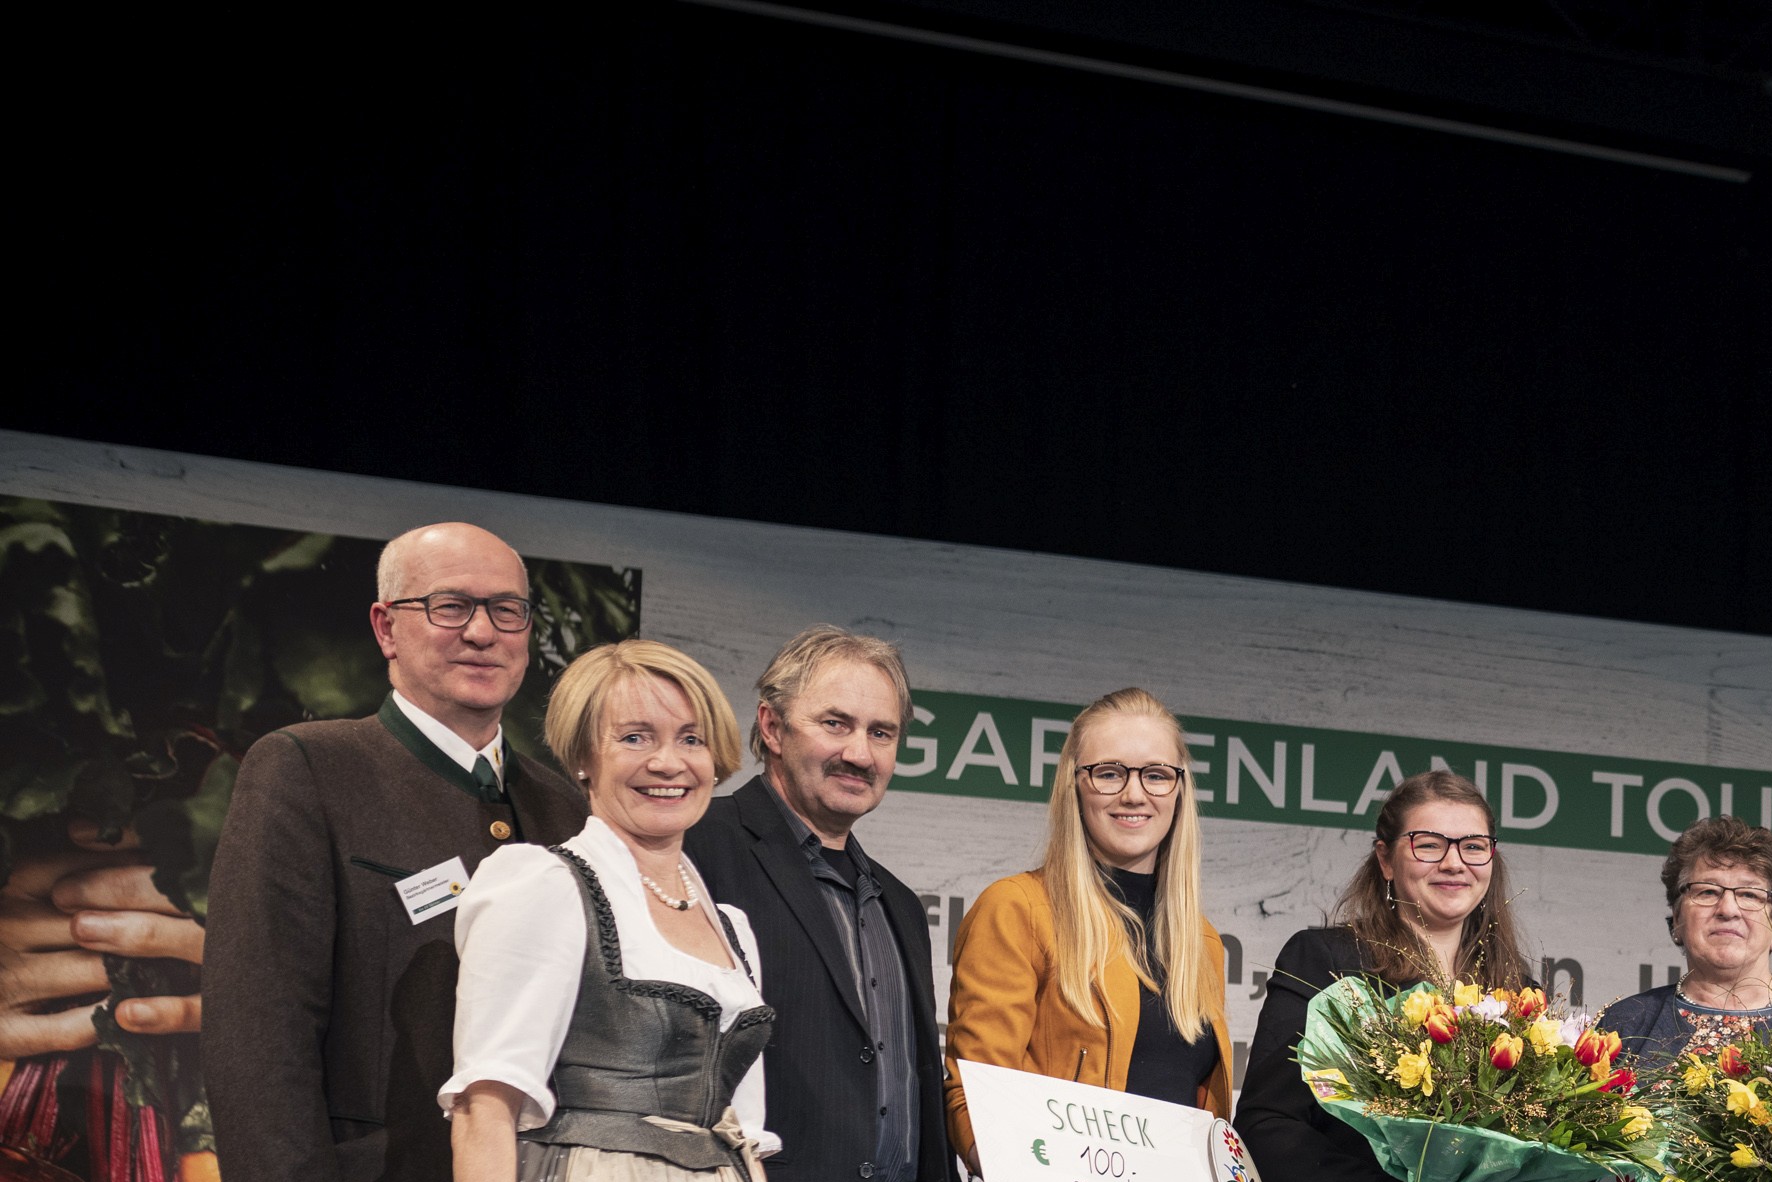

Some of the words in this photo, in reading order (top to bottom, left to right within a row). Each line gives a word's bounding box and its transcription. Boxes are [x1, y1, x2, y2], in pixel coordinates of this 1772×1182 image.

[892, 706, 1560, 830] GAENLAND
[1047, 1099, 1155, 1149] SCHECK
[1030, 1138, 1050, 1166] €
